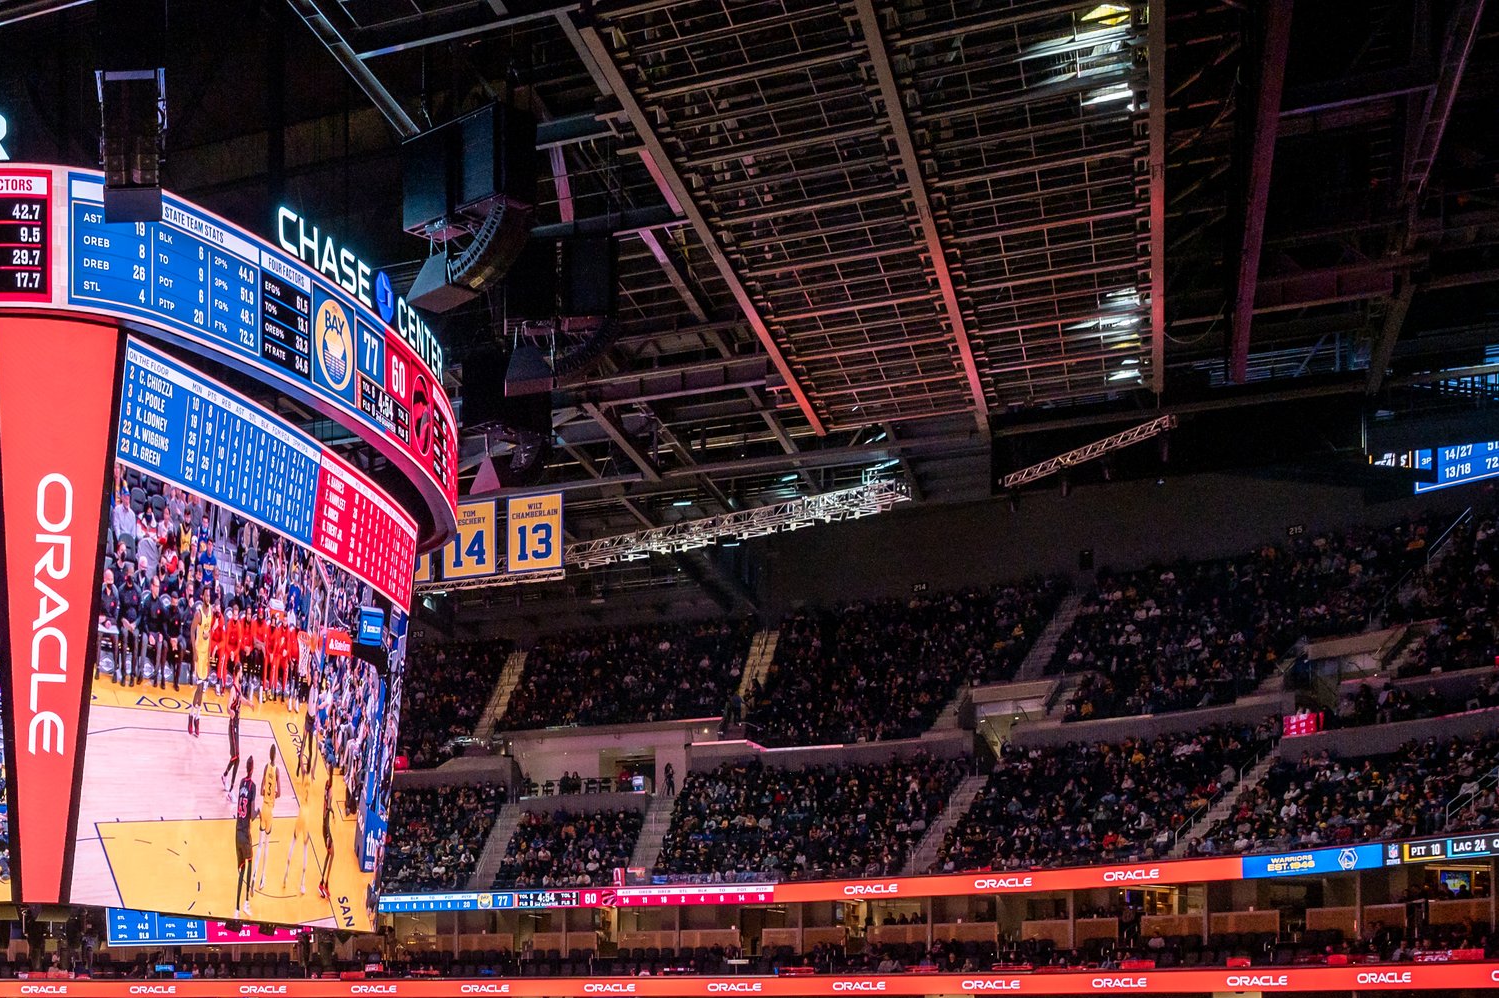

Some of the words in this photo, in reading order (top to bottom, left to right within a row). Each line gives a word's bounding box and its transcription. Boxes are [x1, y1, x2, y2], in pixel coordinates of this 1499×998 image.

[12, 204, 40, 219] 42.7
[164, 206, 186, 226] STATE
[186, 214, 203, 234] TEAM
[205, 224, 224, 244] STATS
[20, 227, 40, 242] 9.5
[12, 250, 40, 265] 29.7
[15, 272, 40, 288] 17.7
[278, 206, 372, 308] CHASE
[398, 297, 443, 385] CENTER
[325, 309, 345, 335] BAY
[363, 331, 379, 376] 77
[392, 355, 406, 399] 60
[1444, 444, 1473, 461] 14/27
[1444, 463, 1472, 479] 13/18
[527, 502, 543, 510] WILT
[462, 510, 476, 518] TOM
[512, 508, 559, 520] CHAMBERLAIN
[457, 516, 486, 526] ESCHERY
[517, 523, 552, 561] 13
[453, 530, 486, 568] 14
[28, 473, 73, 756] ORACLE
[1411, 846, 1426, 856] PIT
[1431, 844, 1441, 855] 10
[1453, 841, 1472, 852] LAC
[1475, 839, 1486, 851] 24
[1270, 854, 1313, 864] WARRIORS
[1103, 868, 1160, 882] ORACLE
[843, 883, 898, 895] ORACLE
[974, 877, 1033, 889] ORACLE
[1091, 977, 1147, 988] ORACLE
[1226, 975, 1288, 987] ORACLE
[1356, 971, 1412, 984] ORACLE
[20, 985, 68, 994] ORACLE
[129, 985, 176, 994] ORACLE
[239, 985, 287, 994] ORACLE
[350, 985, 397, 994] ORACLE
[460, 984, 510, 993] ORACLE
[583, 983, 636, 993] ORACLE
[707, 982, 762, 992] ORACLE
[832, 981, 886, 991] ORACLE
[961, 979, 1021, 990] ORACLE
